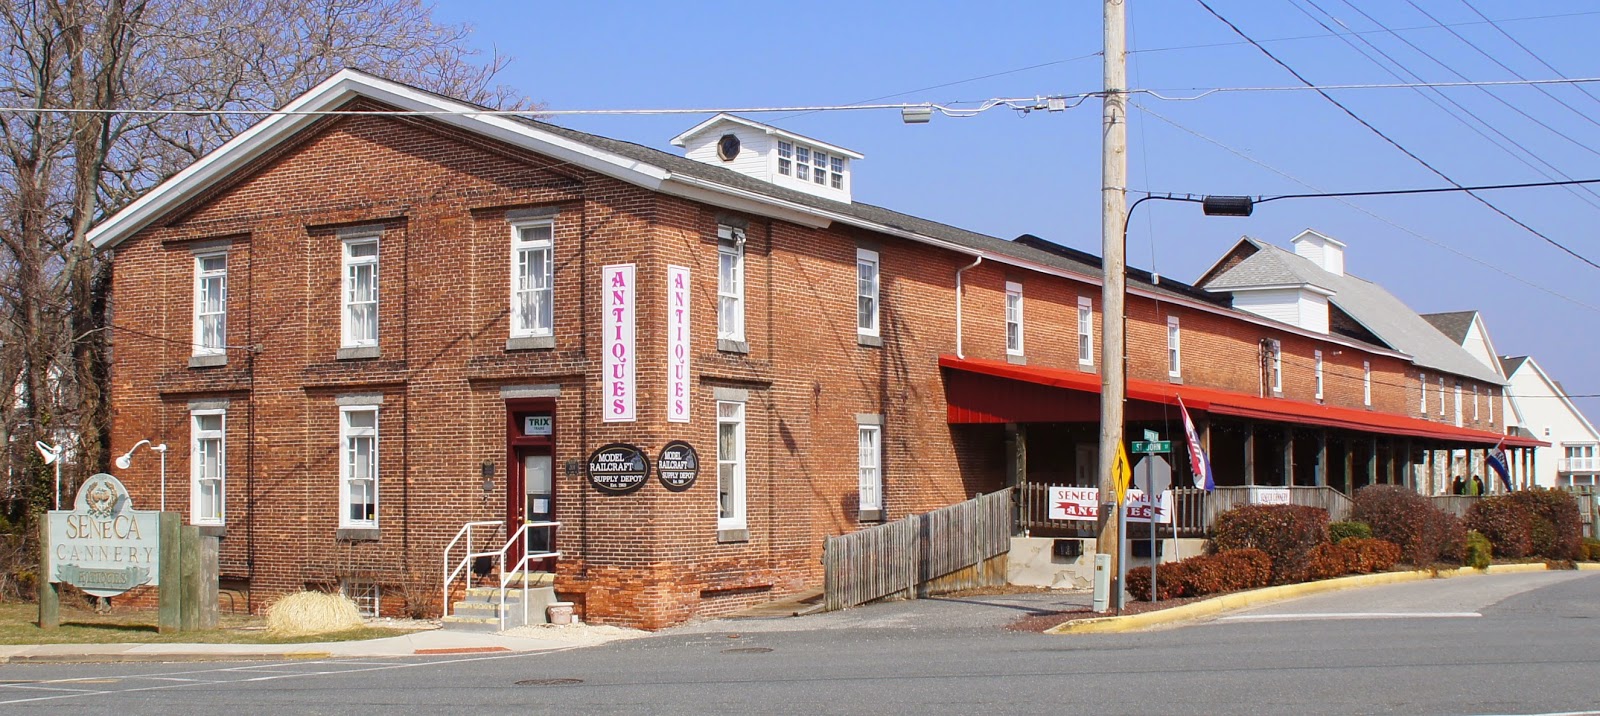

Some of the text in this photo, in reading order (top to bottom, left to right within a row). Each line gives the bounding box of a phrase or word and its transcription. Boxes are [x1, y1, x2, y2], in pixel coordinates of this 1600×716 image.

[611, 271, 626, 415] ANTIQUES
[674, 273, 684, 415] ANTIQUES
[529, 418, 549, 426] TRIX
[1146, 443, 1160, 451] JOHN
[598, 453, 625, 462] MODEL
[664, 451, 682, 460] MODEL
[590, 462, 634, 472] RAILCRAFT
[659, 460, 688, 469] RAILCRAFT
[594, 475, 643, 483] SUPPLY DEPOT
[662, 471, 679, 479] SUPPLY
[66, 514, 141, 540] SENECA
